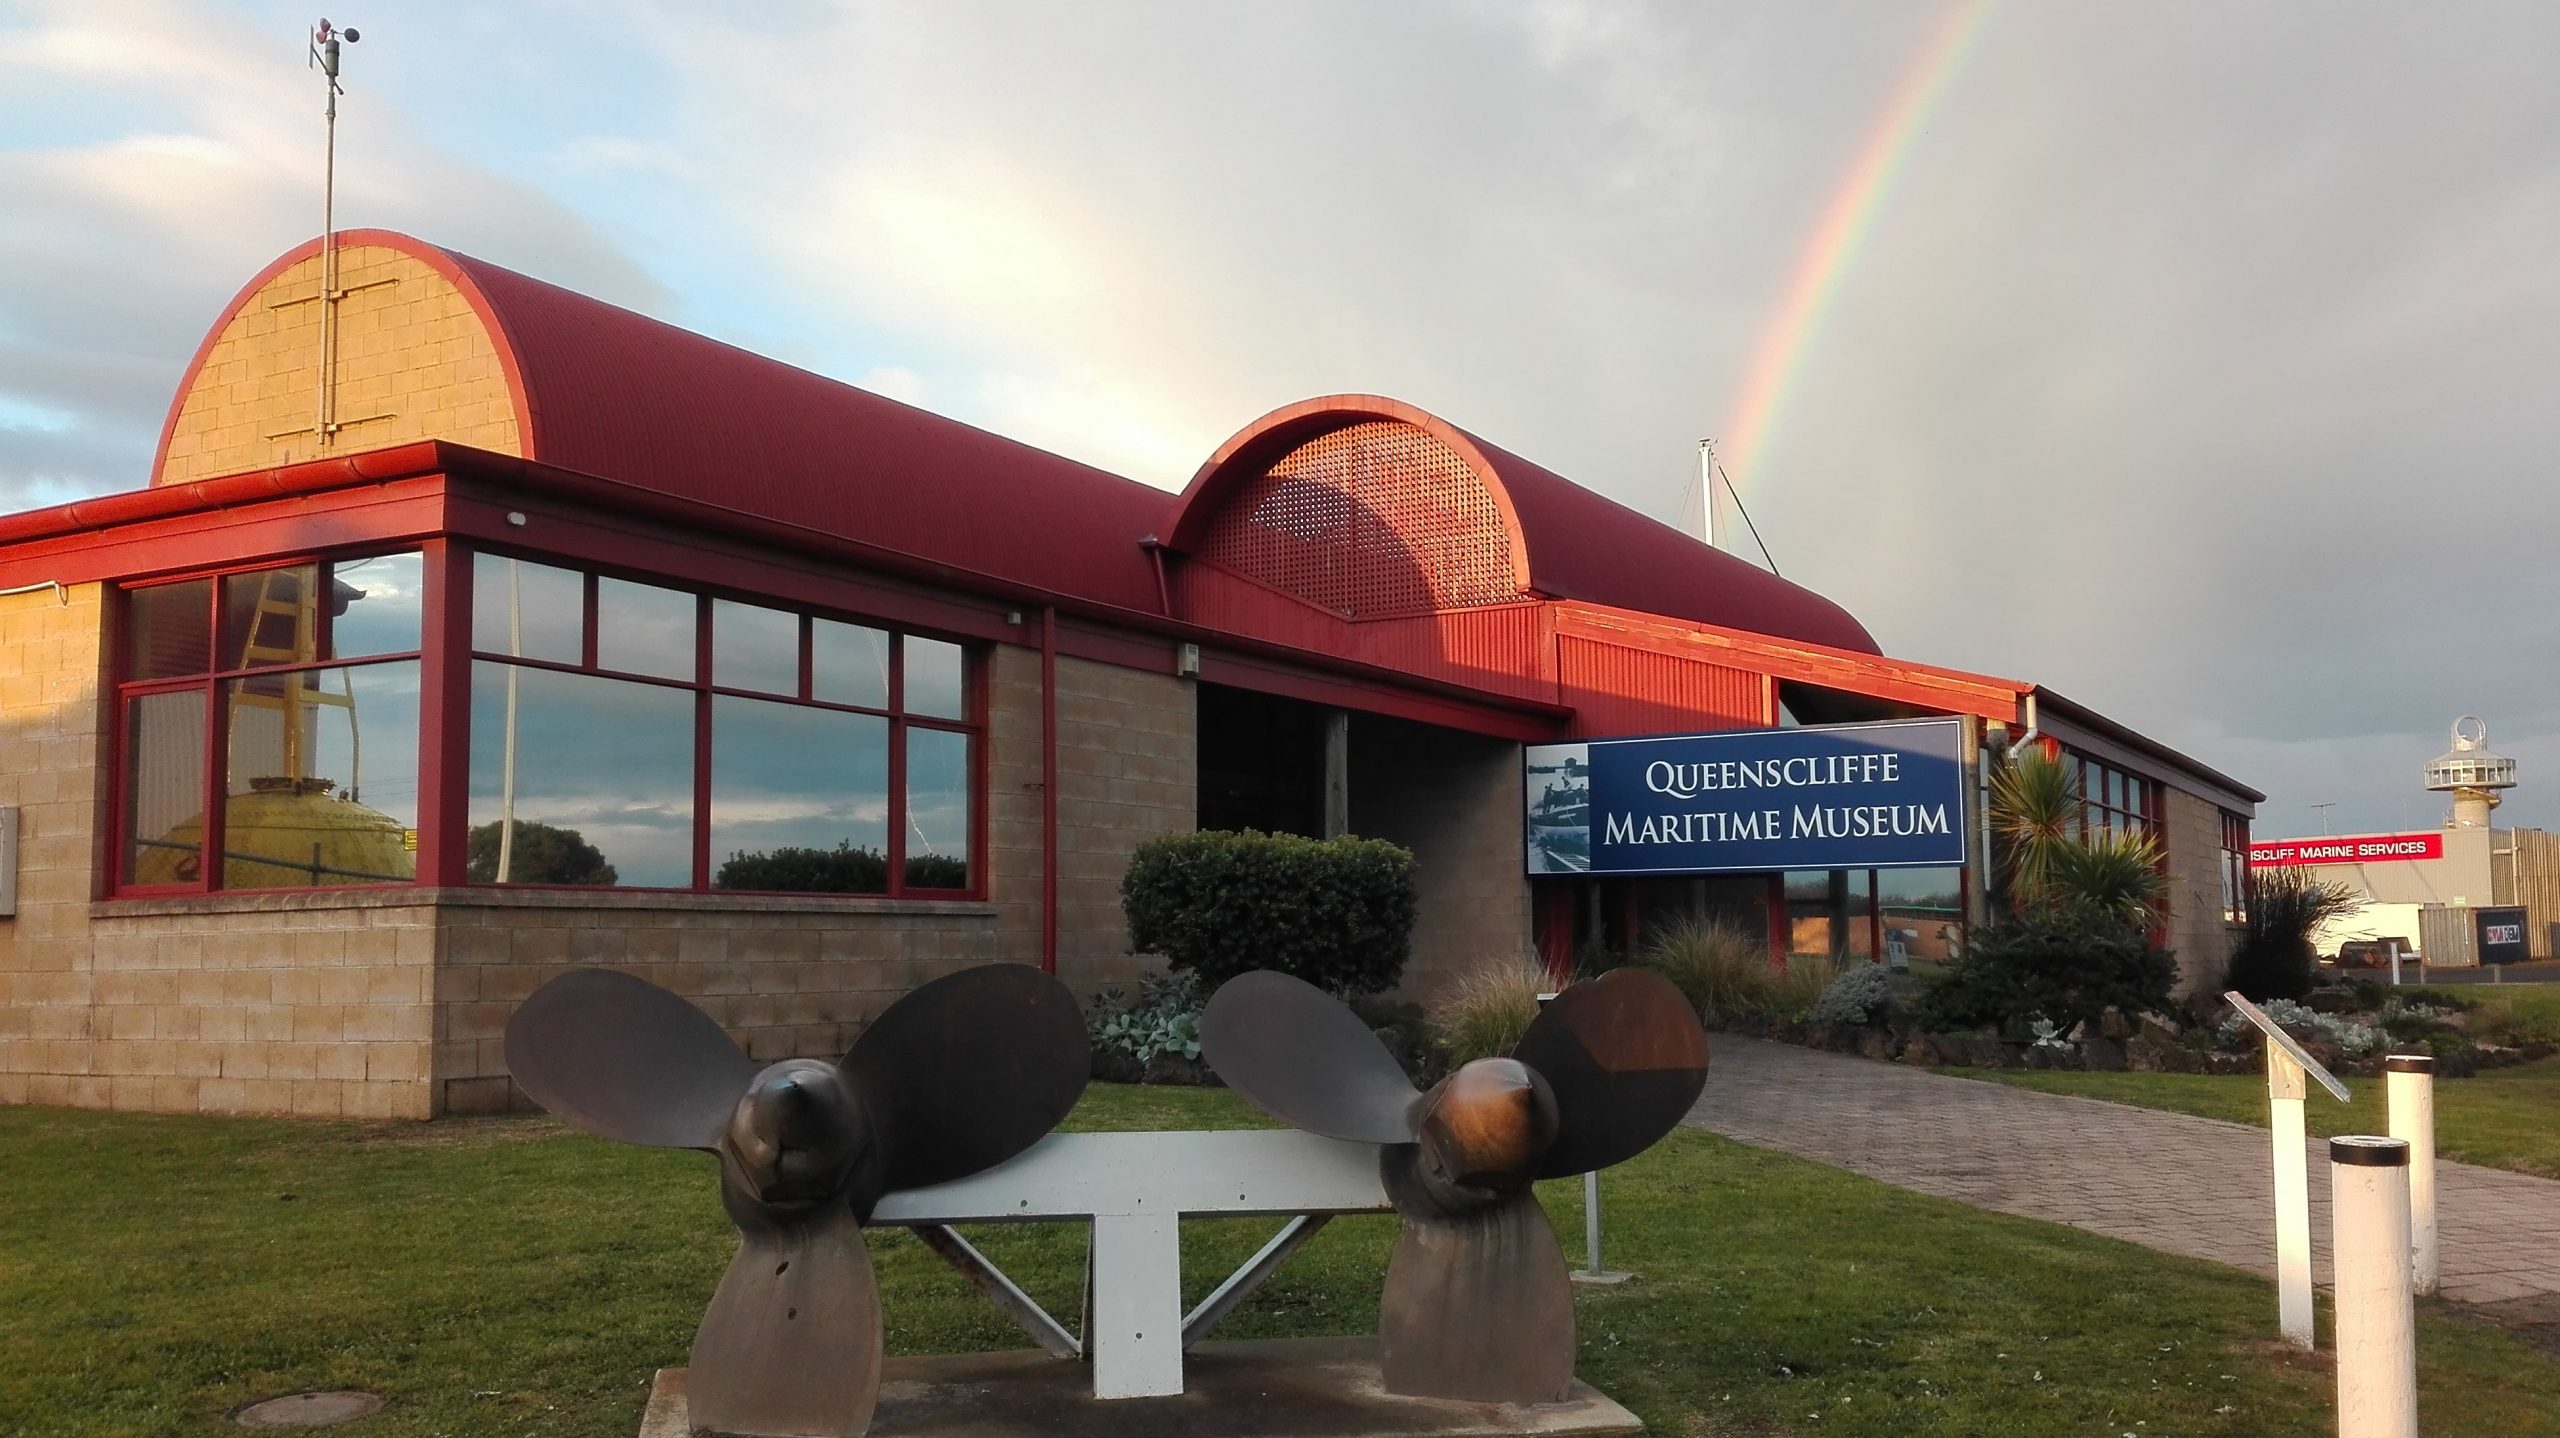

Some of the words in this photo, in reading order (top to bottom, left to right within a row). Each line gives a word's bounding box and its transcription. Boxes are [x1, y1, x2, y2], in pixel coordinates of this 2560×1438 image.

[1645, 753, 1900, 799] QUEENSCLIFFE
[1604, 811, 1781, 846] MARITIME
[1790, 803, 1951, 840] MUSEUM
[2250, 848, 2295, 861] SCLIFF
[2300, 845, 2354, 859] MARINE
[2358, 841, 2427, 856] SERVICES
